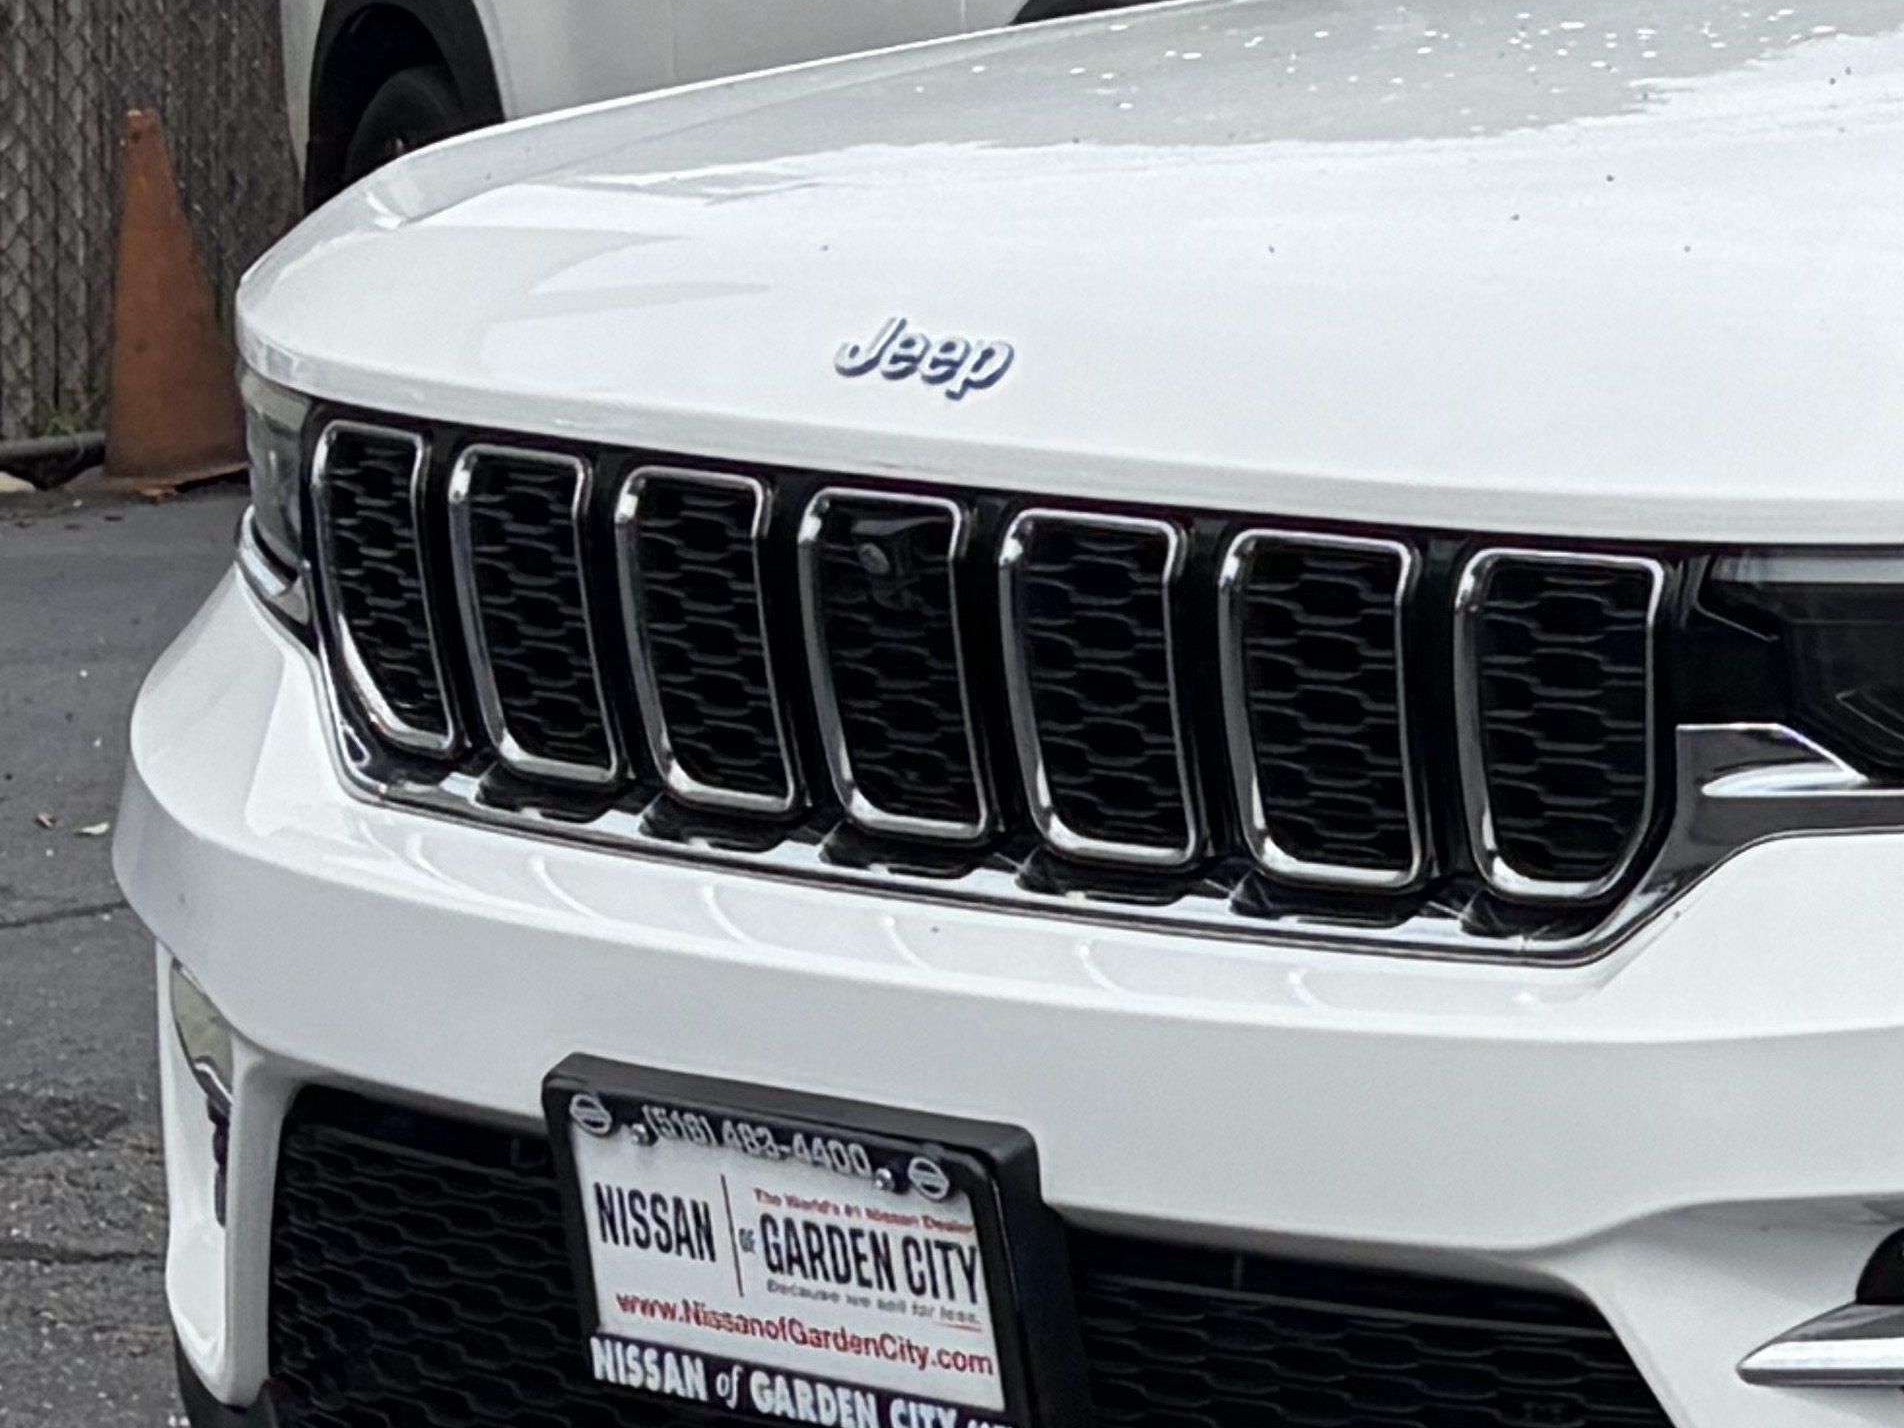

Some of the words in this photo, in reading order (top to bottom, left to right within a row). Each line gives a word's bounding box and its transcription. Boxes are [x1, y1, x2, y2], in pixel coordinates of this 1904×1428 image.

[833, 317, 1015, 401] Jeep
[594, 1182, 716, 1262] NISSAN
[760, 1213, 896, 1292] GARDEN
[902, 1236, 977, 1304] CITY
[590, 1336, 709, 1402] NISSAN
[716, 1365, 743, 1410] of
[616, 1293, 993, 1375] www.NissanofGardenCity.com
